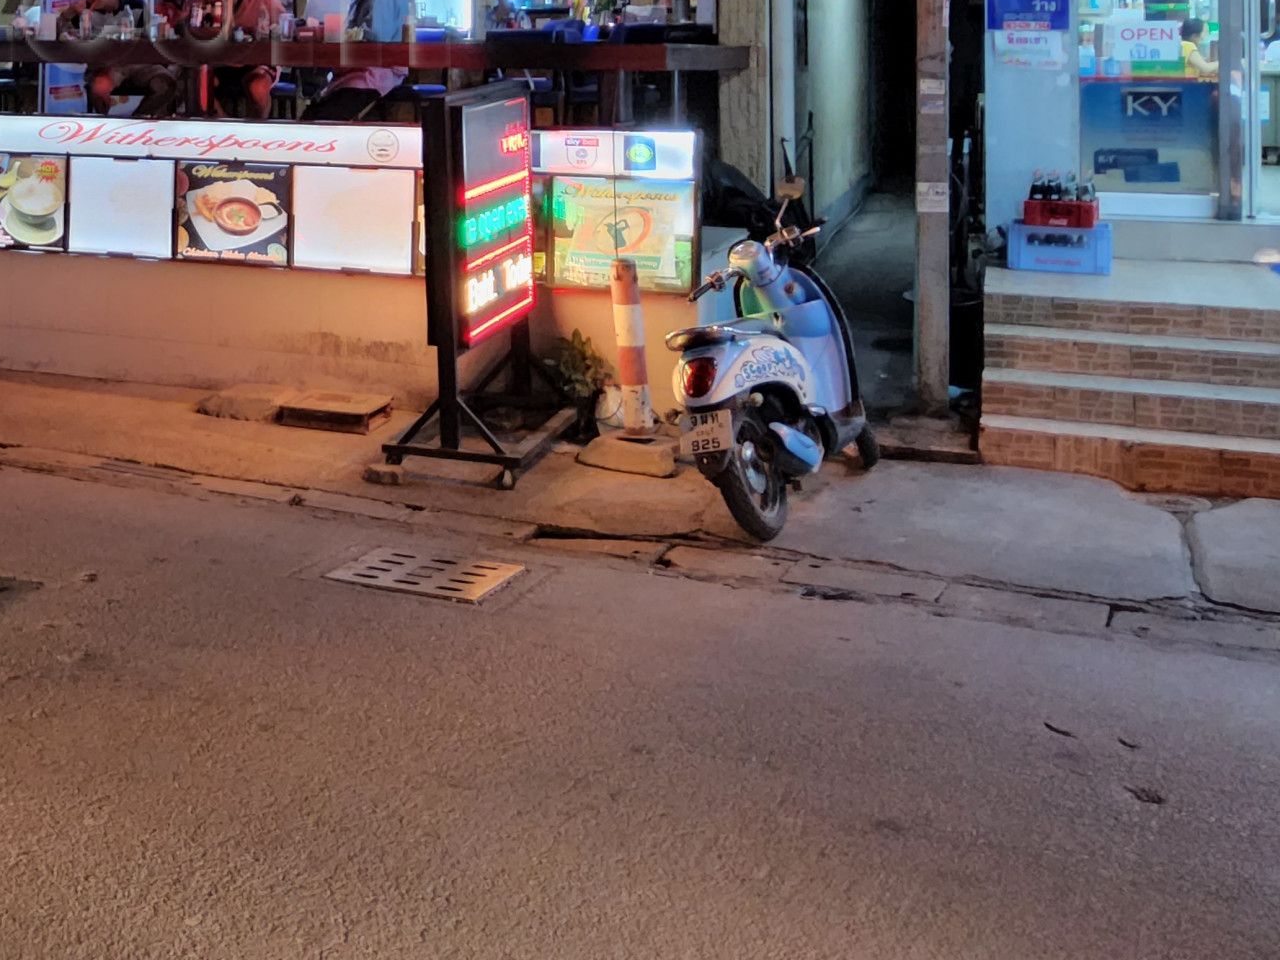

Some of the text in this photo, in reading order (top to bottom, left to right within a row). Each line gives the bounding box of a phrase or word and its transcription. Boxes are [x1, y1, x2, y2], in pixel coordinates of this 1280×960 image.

[1121, 26, 1174, 41] OPEN
[38, 120, 339, 156] Witherspoons
[691, 437, 721, 452] 825
